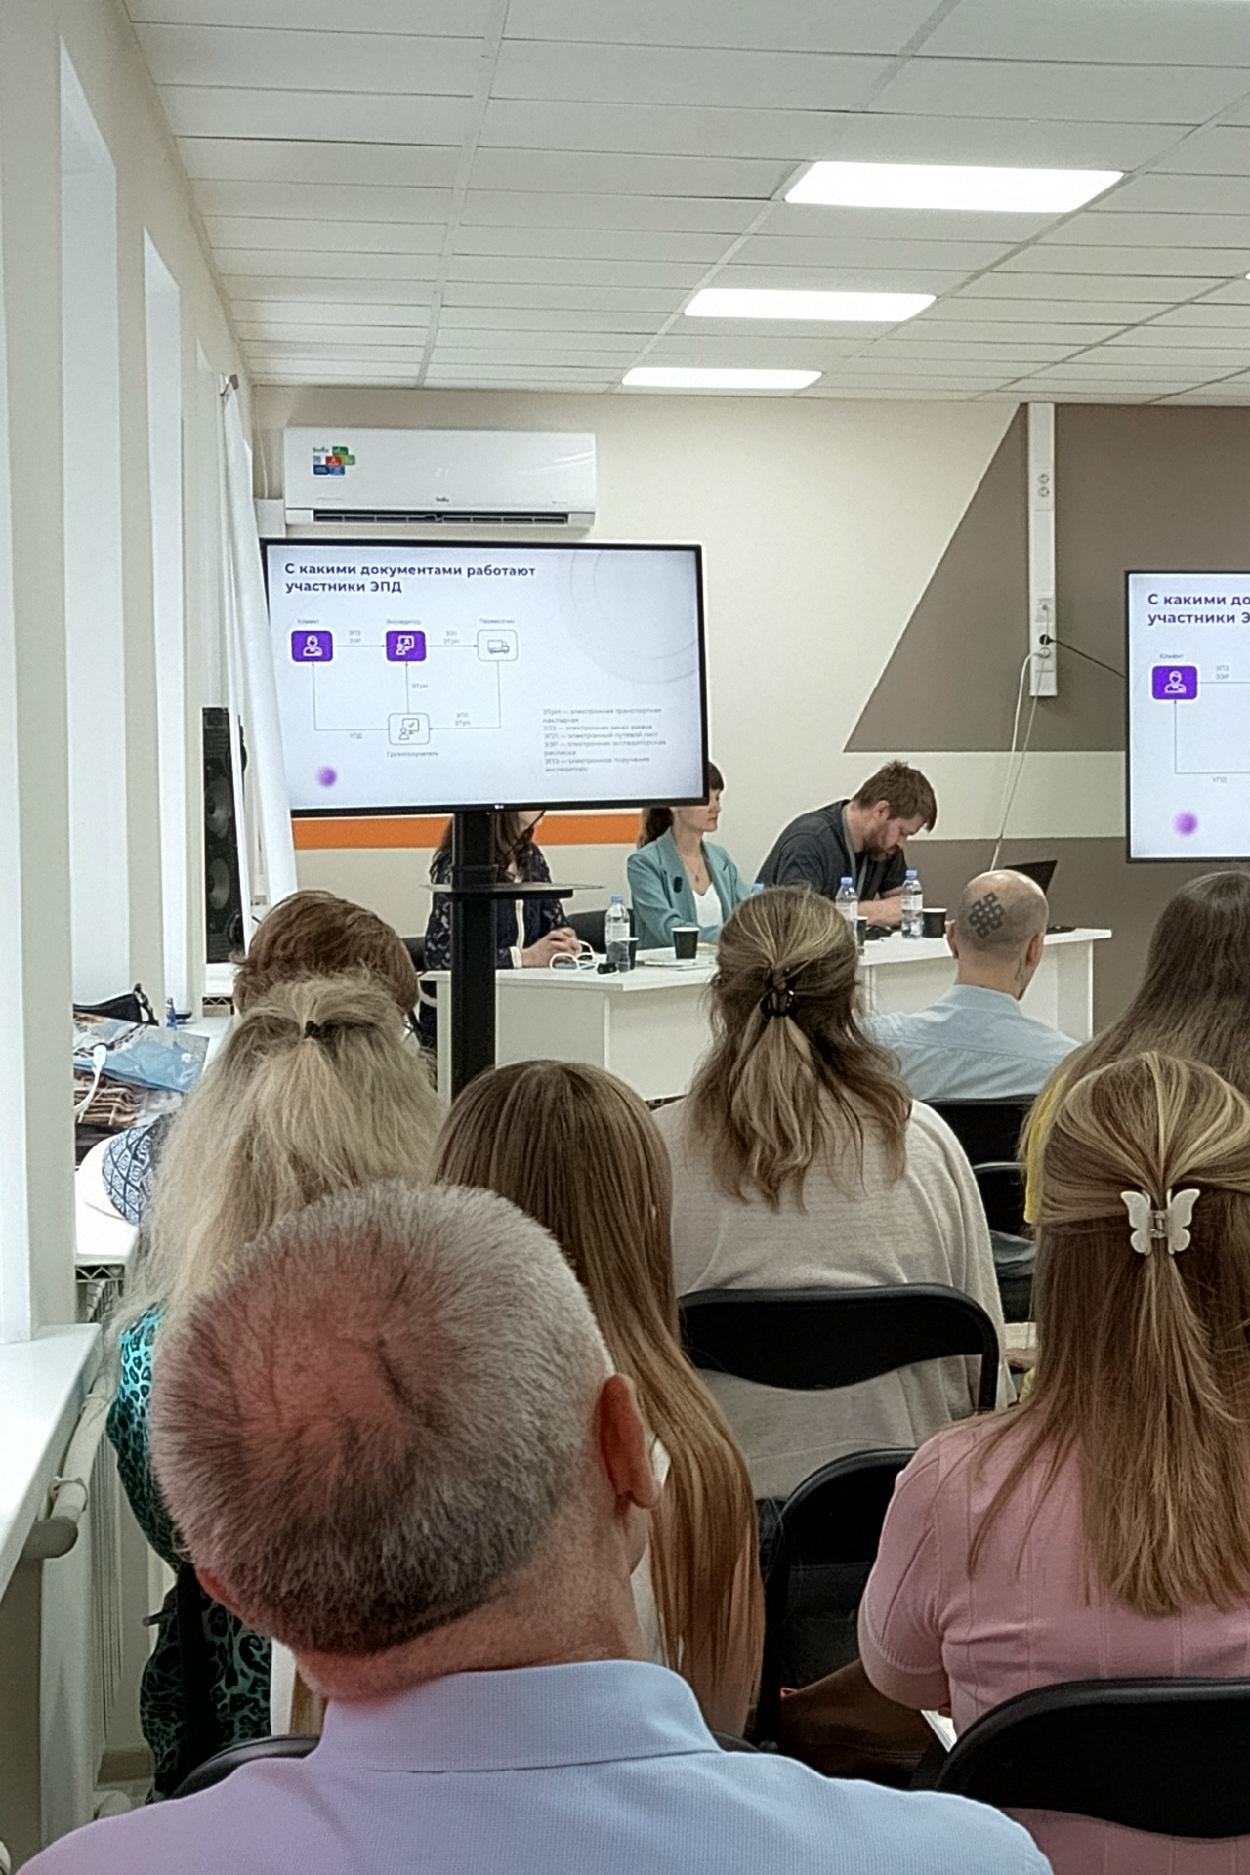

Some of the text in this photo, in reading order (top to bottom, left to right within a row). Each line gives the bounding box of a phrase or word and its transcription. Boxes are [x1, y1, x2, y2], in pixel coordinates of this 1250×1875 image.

[284, 562, 536, 578] С какими документами работают
[285, 581, 402, 594] участники ЭПД
[1148, 594, 1158, 605] С
[1164, 594, 1226, 606] какими
[1147, 612, 1236, 626] участники
